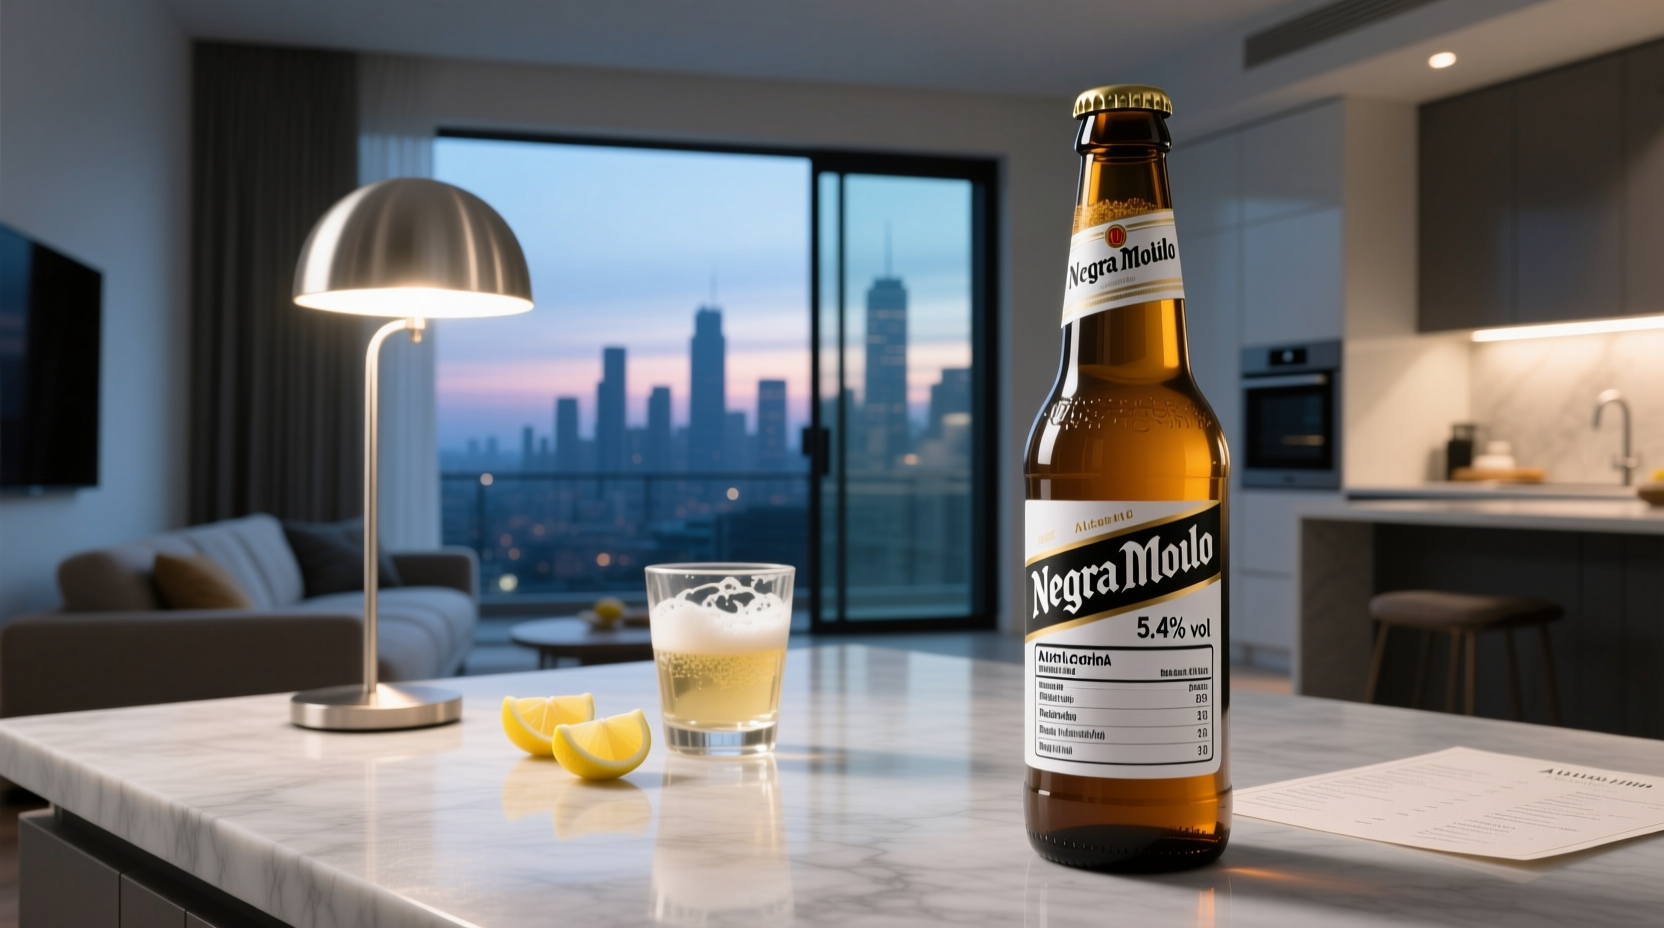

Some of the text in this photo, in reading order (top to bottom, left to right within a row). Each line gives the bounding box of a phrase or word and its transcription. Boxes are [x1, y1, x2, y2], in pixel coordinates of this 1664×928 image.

[1069, 256, 1118, 289] Negra
[1031, 561, 1119, 619] Negra
[1137, 616, 1210, 639] 5.4% vol
